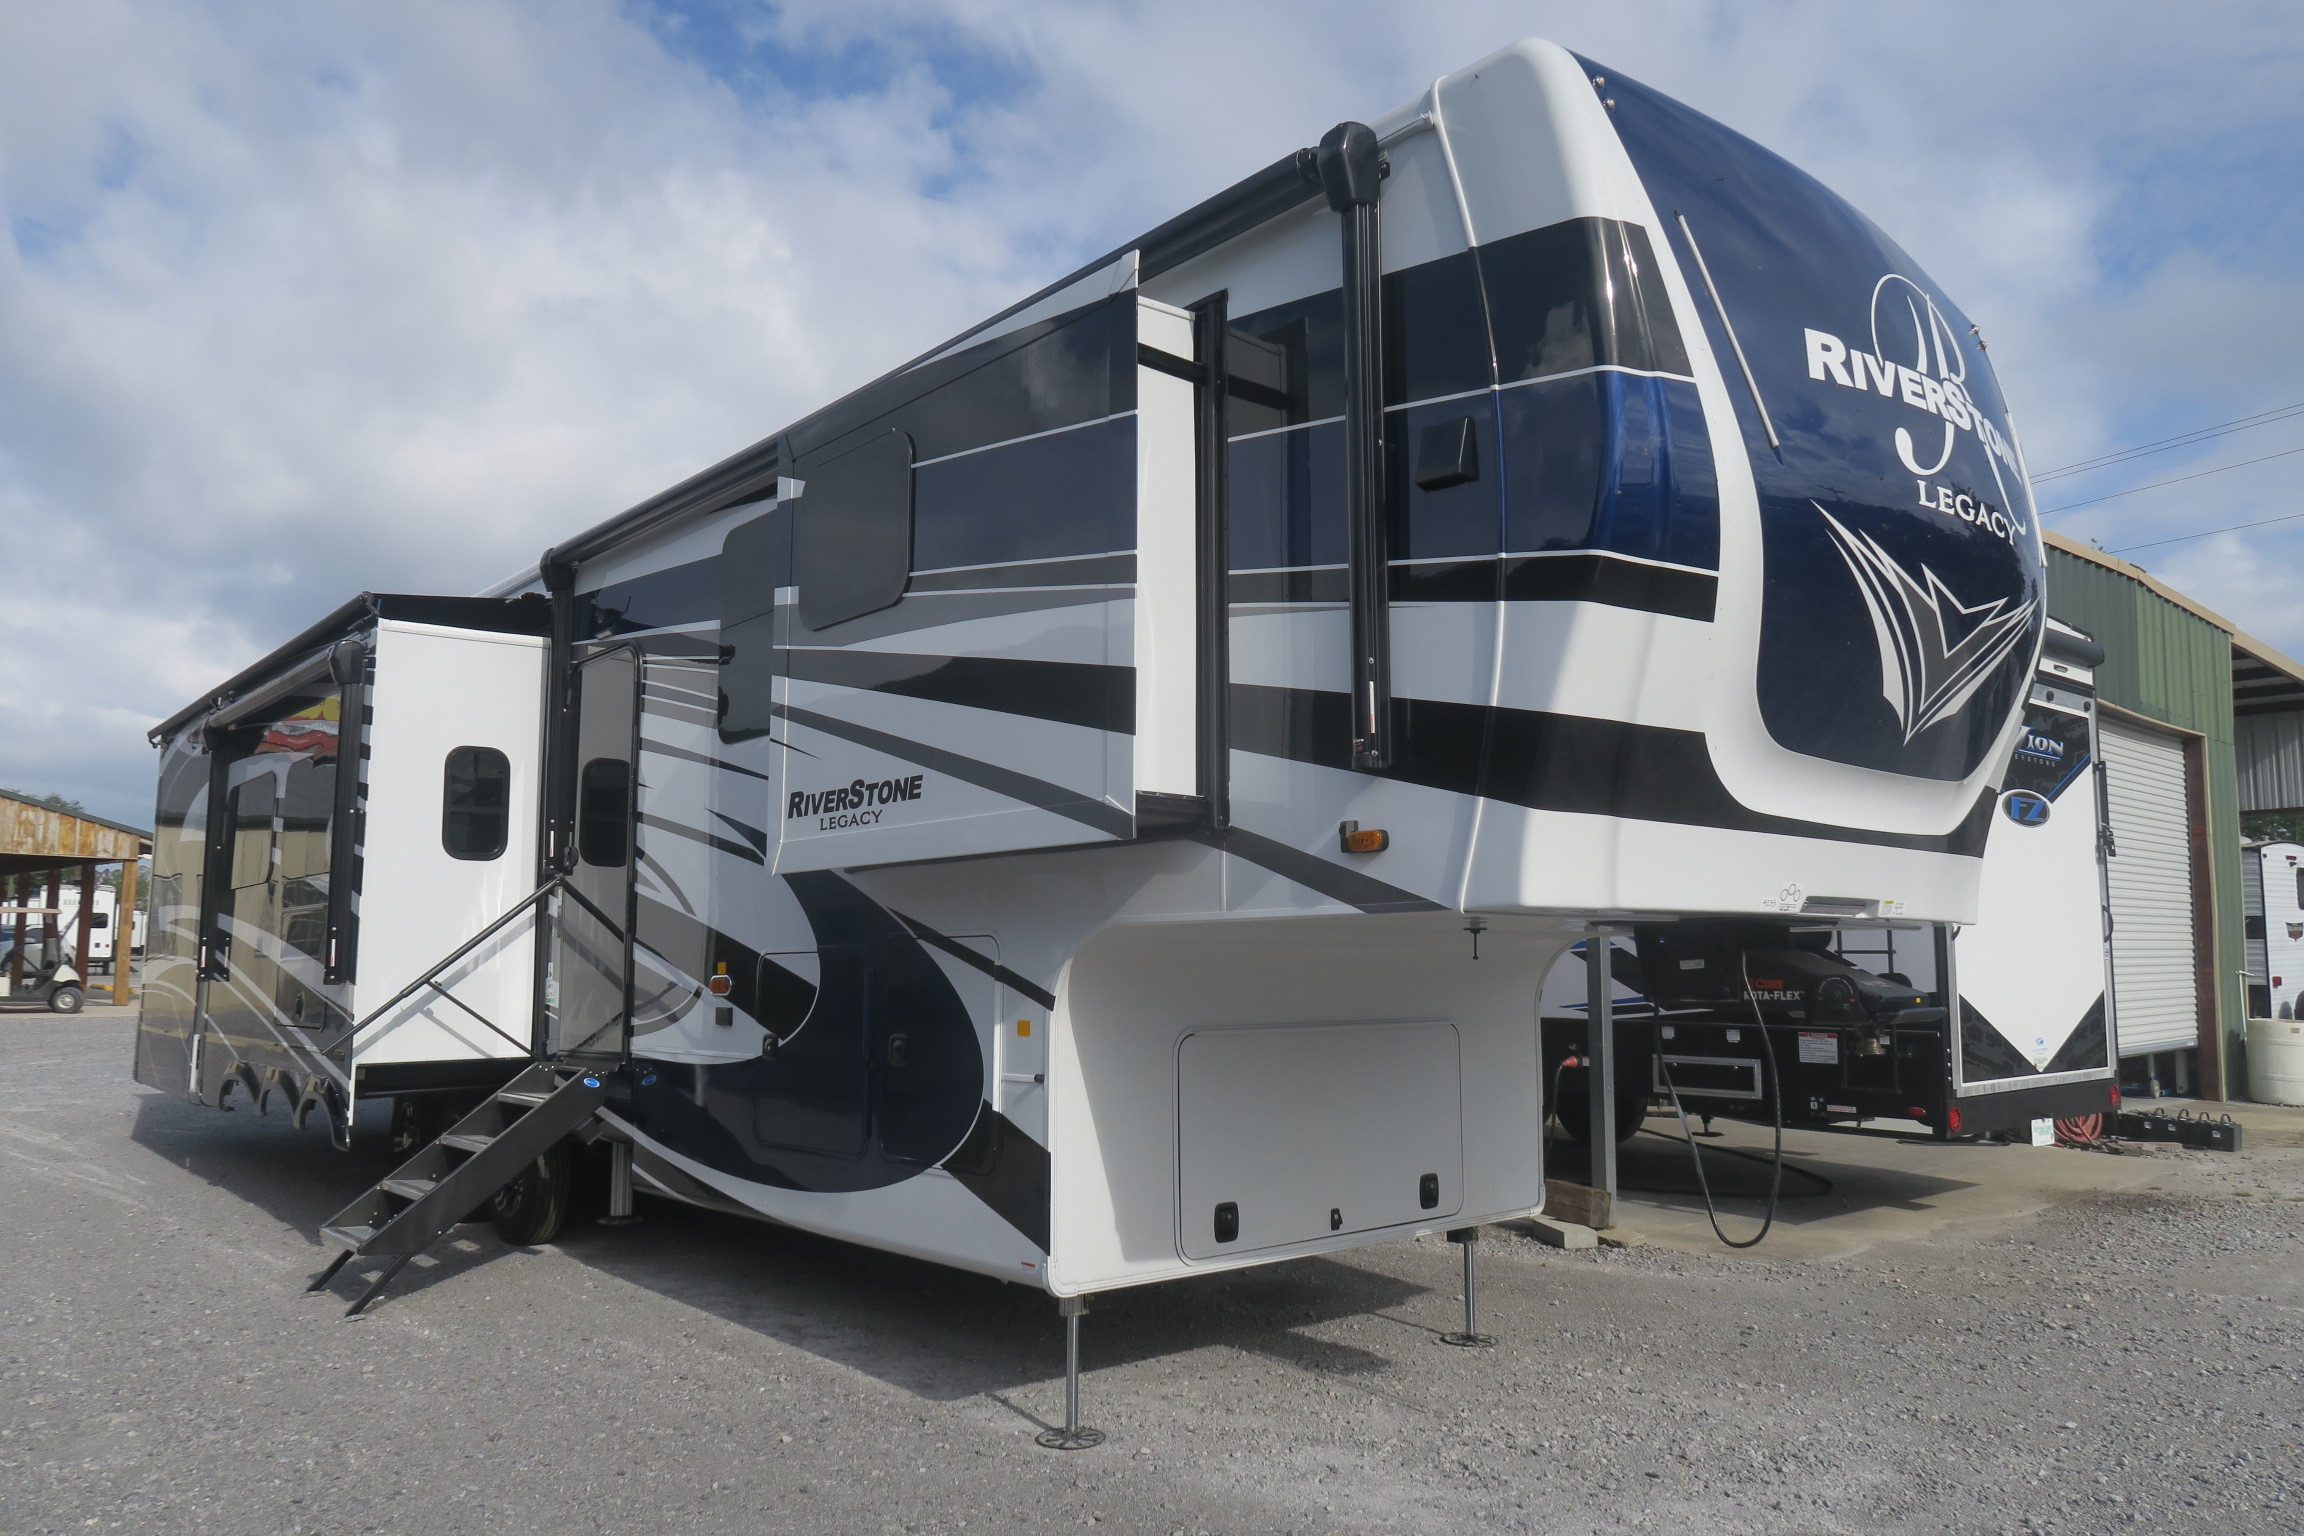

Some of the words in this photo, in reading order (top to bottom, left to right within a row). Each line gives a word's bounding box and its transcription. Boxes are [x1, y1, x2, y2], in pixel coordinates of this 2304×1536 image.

[1917, 479, 2016, 546] LEGACY
[788, 774, 923, 819] RIVERSTONE
[820, 809, 883, 831] LEGACY
